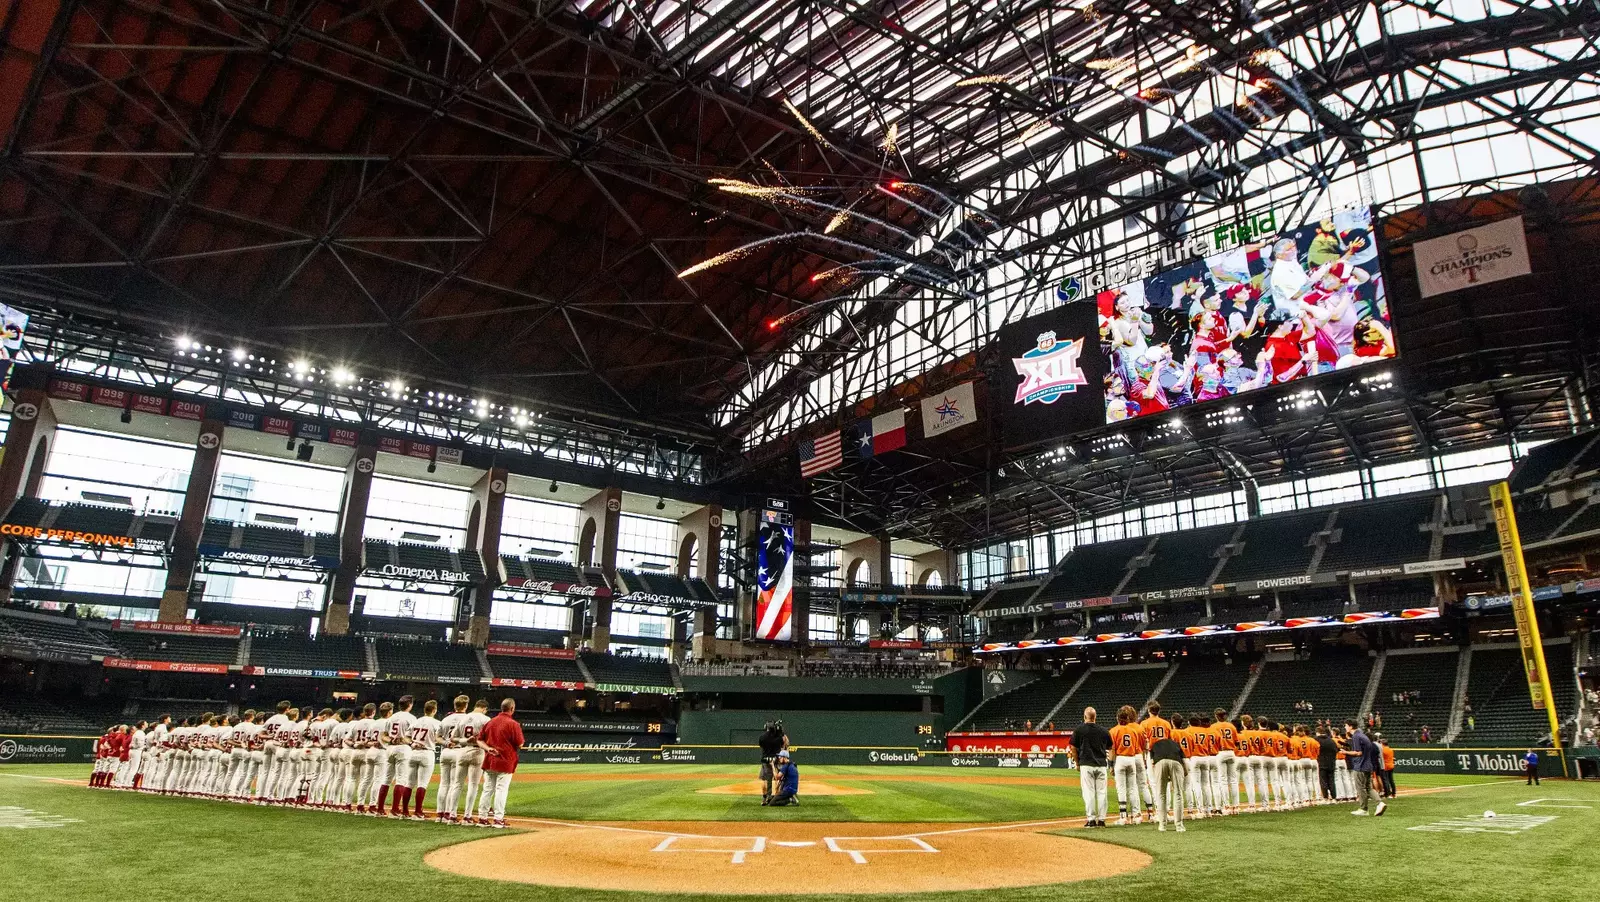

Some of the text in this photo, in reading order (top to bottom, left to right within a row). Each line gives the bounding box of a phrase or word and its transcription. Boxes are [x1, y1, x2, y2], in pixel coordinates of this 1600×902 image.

[1088, 208, 1276, 290] Globe Life Field
[1430, 247, 1512, 275] CHAMPIONS
[1016, 341, 1084, 400] XII
[100, 388, 124, 399] 1998
[1029, 385, 1072, 399] CHAMPIONSHIP
[18, 406, 34, 417] 42
[176, 402, 200, 412] 2010
[232, 412, 254, 422] 2010
[932, 414, 964, 430] ARLINGTON
[269, 418, 288, 428] 2011
[302, 424, 320, 432] 2011
[336, 430, 354, 438] 2012
[202, 436, 217, 446] 34
[412, 442, 430, 452] 2016
[358, 460, 372, 470] 26
[712, 517, 719, 526] 10
[0, 524, 135, 548] CORE PERSONNEL
[222, 551, 304, 565] LOCKHEED MARTIN
[440, 570, 470, 582] Bank
[1256, 576, 1312, 589] POWERADE
[637, 592, 683, 604] CHOCTAW
[1146, 591, 1166, 599] PGL
[985, 604, 1043, 617] UT DALLAS
[267, 668, 312, 676] GARDENERS
[603, 684, 676, 694] LUXOR STAFFING
[392, 723, 399, 735] 5
[413, 728, 428, 741] 77
[464, 726, 474, 737] 8
[1152, 727, 1164, 738] 10
[1221, 729, 1232, 740] 12
[1123, 735, 1131, 746] 6
[1195, 734, 1205, 745] 17
[1301, 740, 1307, 749] 2
[527, 743, 581, 752] LOCKHEED
[1046, 745, 1071, 753] Stat
[606, 754, 640, 763] VERYABLE
[880, 753, 918, 761] Globe Life
[1457, 754, 1528, 771] T Mobile
